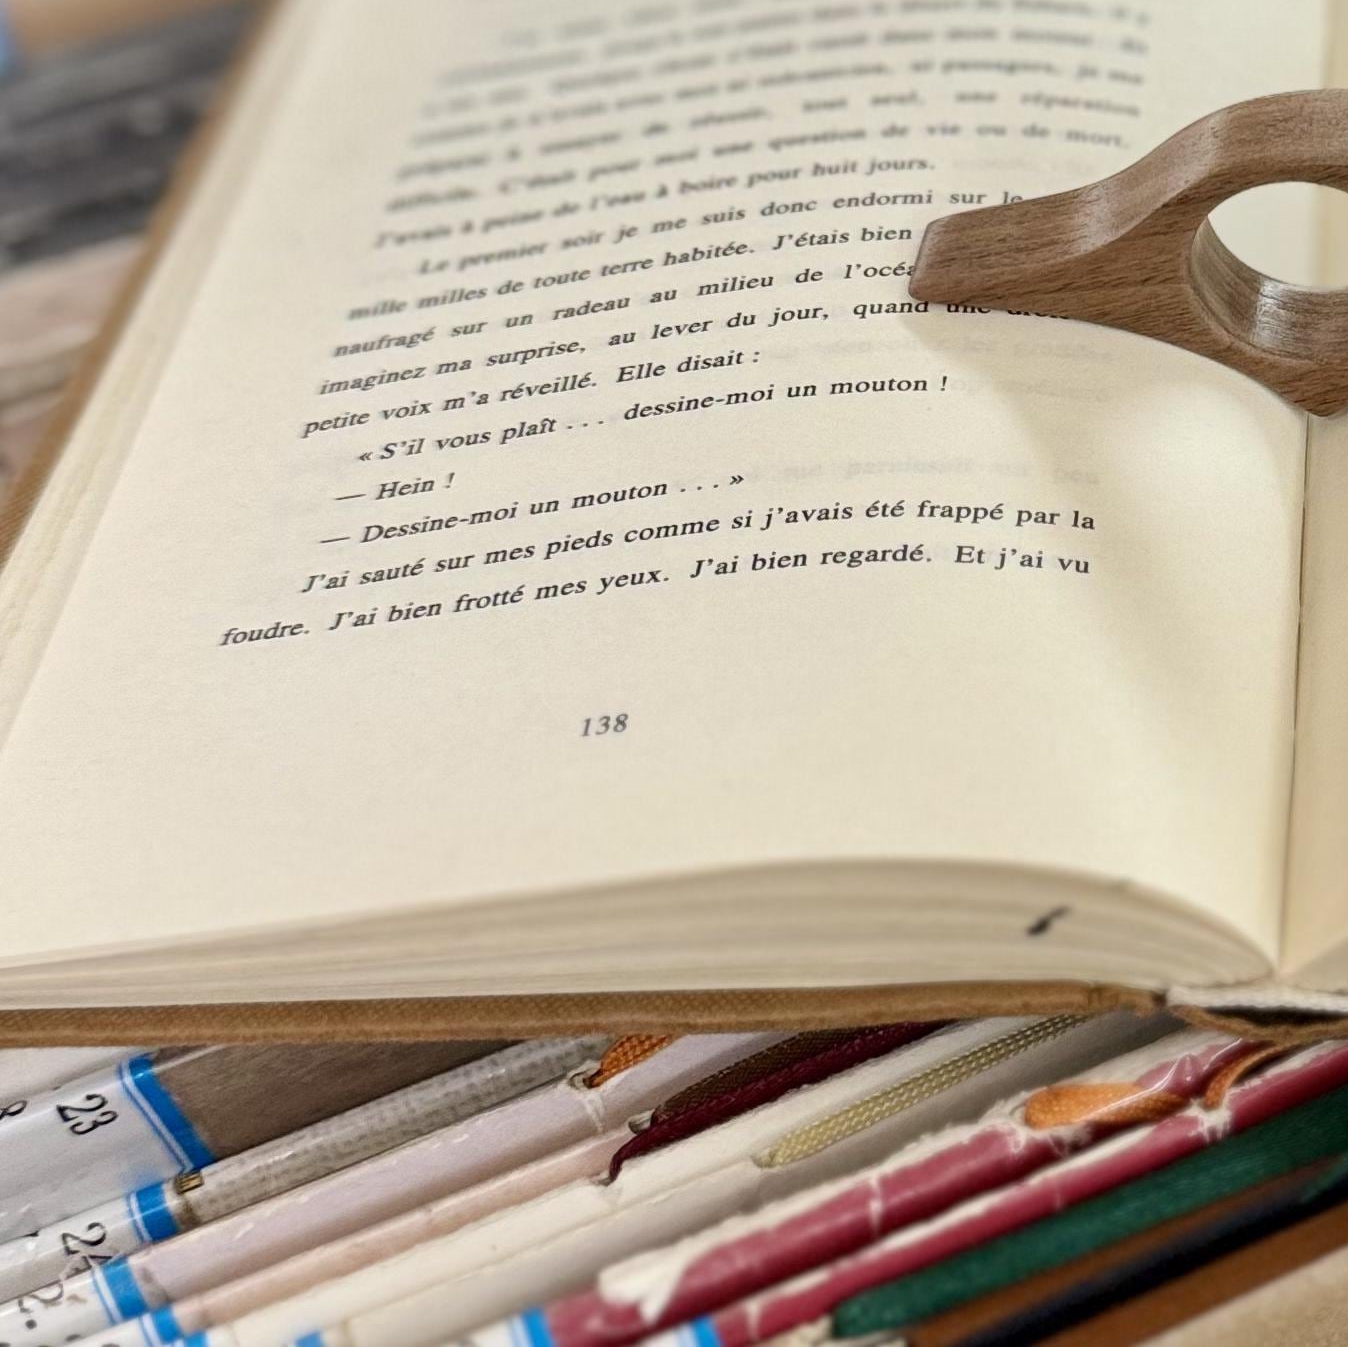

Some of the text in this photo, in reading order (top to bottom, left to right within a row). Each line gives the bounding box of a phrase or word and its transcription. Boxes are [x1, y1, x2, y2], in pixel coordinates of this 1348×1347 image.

[611, 224, 640, 246] je
[649, 216, 689, 235] me
[699, 205, 748, 227] suis
[758, 198, 819, 218] donc
[830, 188, 934, 210] endormi
[947, 192, 989, 206] sur
[531, 268, 593, 291] toute
[599, 255, 655, 281] terre
[660, 240, 757, 268] habitée.
[858, 224, 914, 243] bien
[331, 324, 438, 359] naufragé
[448, 320, 490, 339] sur
[502, 312, 535, 330] un
[550, 295, 632, 322] radeau
[646, 288, 679, 305] au
[694, 274, 776, 298] milieu
[792, 266, 825, 285] de
[316, 365, 429, 397] imaginez
[433, 357, 474, 379] ma
[483, 339, 588, 368] surprise,
[606, 330, 638, 348] au
[648, 318, 715, 341] lever
[724, 310, 758, 330] du
[766, 305, 831, 329] jour,
[851, 301, 930, 321] quand
[298, 410, 372, 441] petite
[377, 398, 434, 422] voix
[497, 370, 599, 404] réveillé.
[614, 360, 668, 385] Elle
[674, 348, 746, 374] disait
[433, 430, 493, 452] vous
[497, 416, 559, 447] plaît
[622, 382, 776, 422] dessine-moi
[785, 383, 819, 400] un
[827, 376, 929, 397] mouton
[358, 482, 669, 545] Dessine-moi un mouton
[372, 476, 437, 502] Hein
[356, 556, 428, 587] sauté
[431, 553, 477, 574] sur
[481, 543, 537, 566] mes
[542, 528, 615, 562] pieds
[622, 517, 722, 545] comme
[729, 508, 755, 531] si
[863, 498, 907, 520] été
[915, 498, 1006, 526] frappé
[1013, 508, 1062, 529] par
[1070, 508, 1097, 532] la
[217, 620, 312, 648] foudre.
[385, 600, 444, 624] bien
[450, 582, 527, 614] frotté
[532, 578, 589, 602] mes
[594, 568, 671, 597] yeux.
[750, 549, 809, 573] bien
[818, 542, 934, 570] regardé.
[952, 543, 988, 566] Et
[1056, 556, 1092, 575] vu
[580, 711, 630, 739] 138
[56, 1093, 119, 1136] 23
